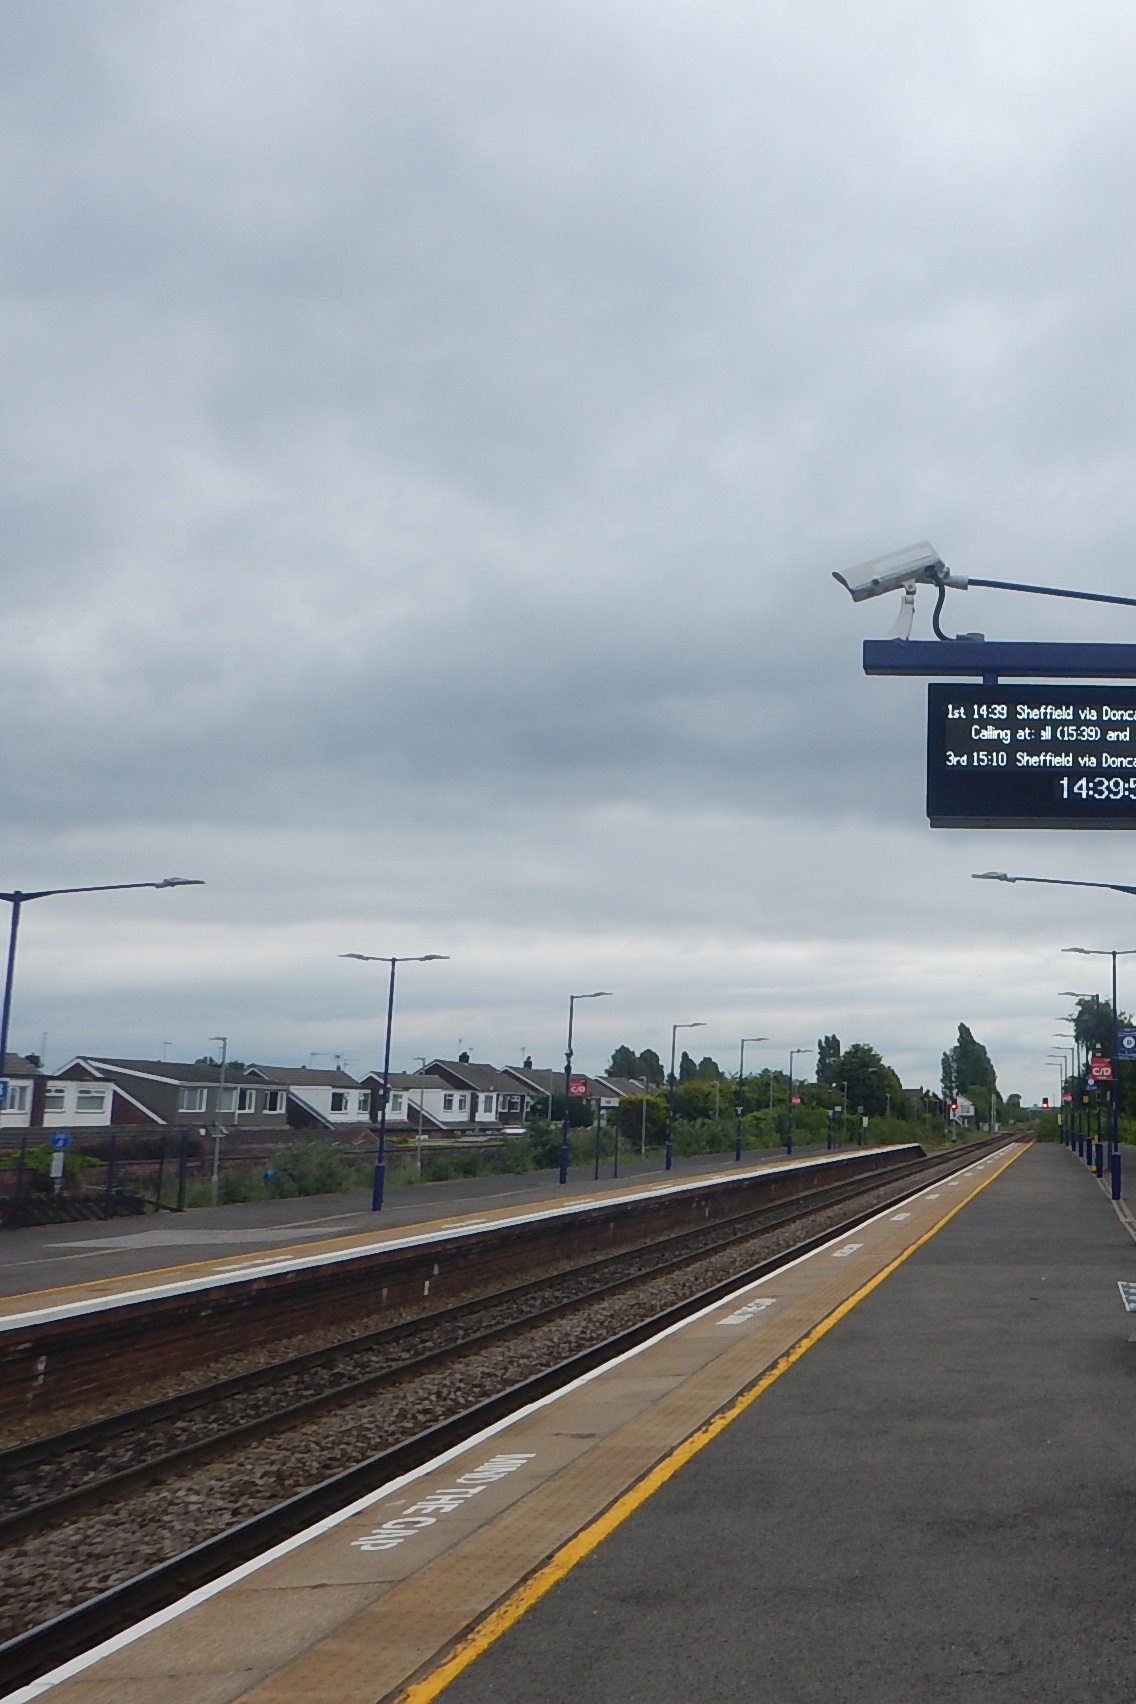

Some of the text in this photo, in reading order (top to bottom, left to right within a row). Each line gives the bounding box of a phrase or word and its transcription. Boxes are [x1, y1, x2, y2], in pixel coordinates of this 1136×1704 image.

[947, 704, 967, 719] 1st
[972, 704, 1008, 719] 14:39
[1016, 704, 1073, 720] Sheffield
[1078, 706, 1098, 720] via
[971, 725, 1011, 744] Calling
[1016, 727, 1035, 740] at:
[1056, 726, 1101, 741] (15:39)
[1106, 727, 1130, 742] and
[945, 751, 968, 766] 3rd
[972, 752, 1007, 766] 15:10
[1015, 752, 1073, 767] Sheffield
[1077, 753, 1097, 767] via
[1092, 1067, 1112, 1076] C/D
[350, 1453, 537, 1551] MIND THE GAP
